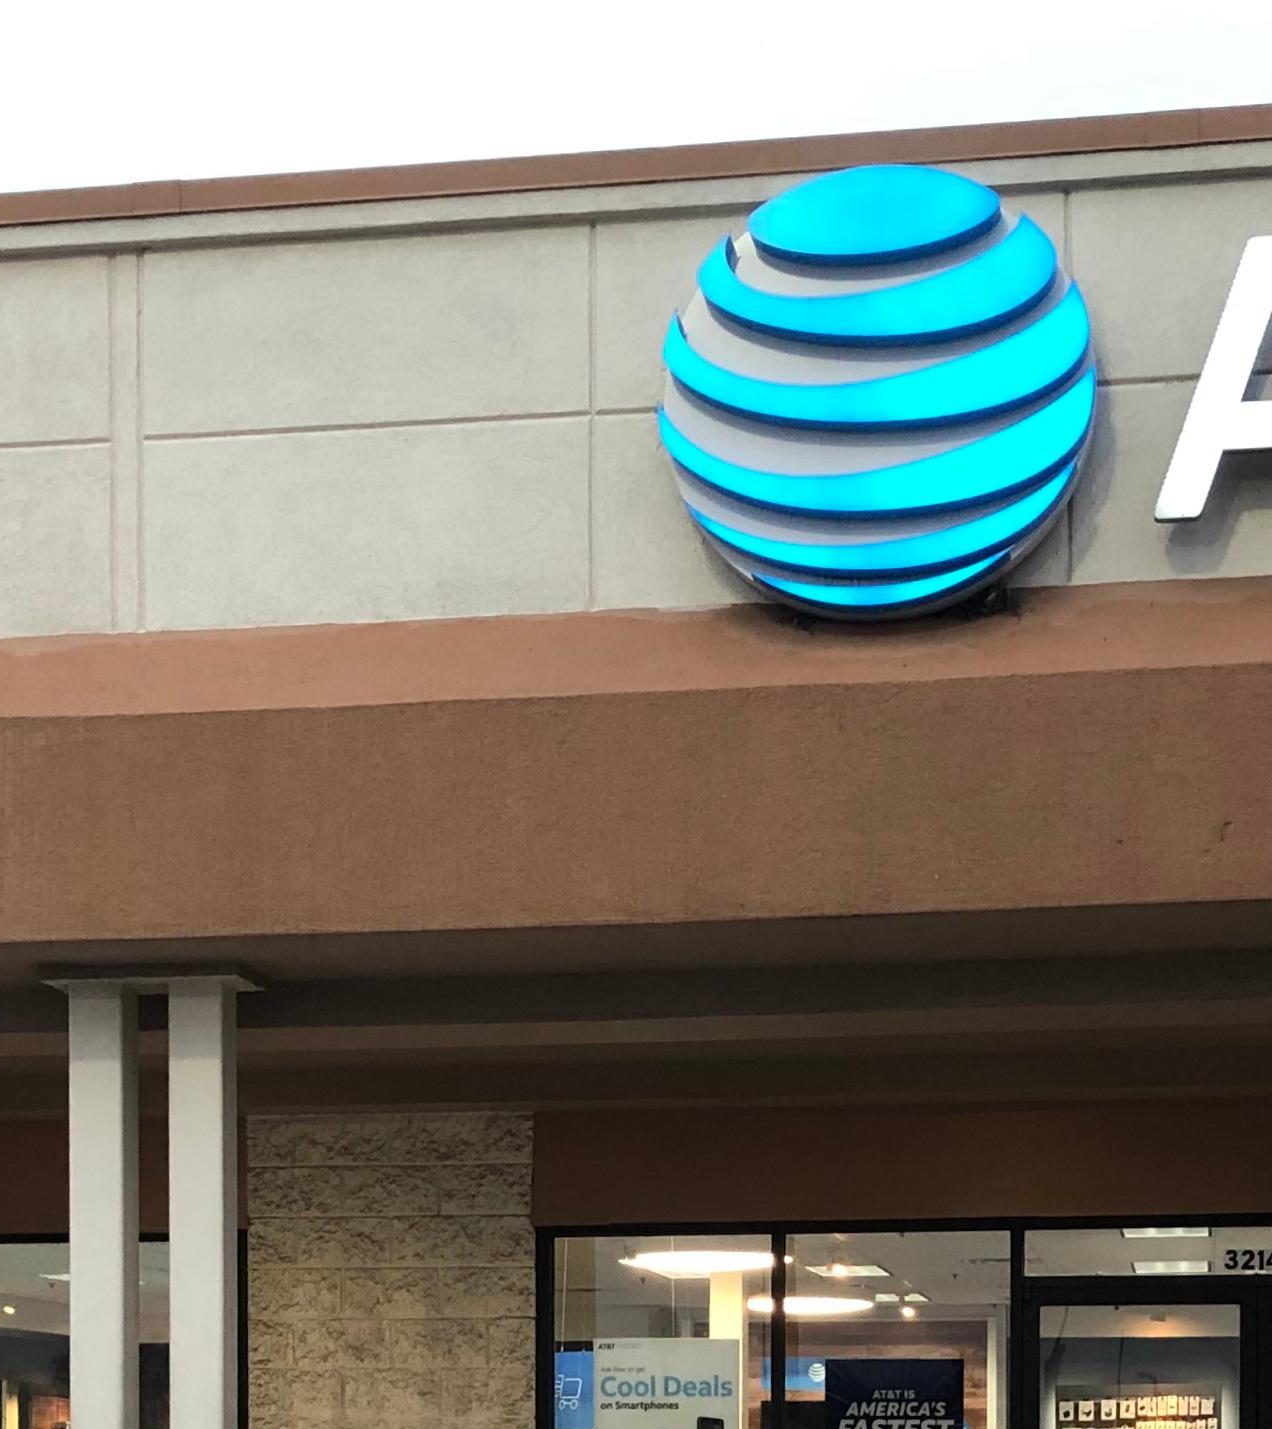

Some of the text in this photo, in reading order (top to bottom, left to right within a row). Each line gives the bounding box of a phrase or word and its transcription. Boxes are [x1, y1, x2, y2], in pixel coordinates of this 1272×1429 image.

[600, 1375, 733, 1398] Cool Deals
[872, 1390, 916, 1399] AT&T IS
[615, 1401, 679, 1411] Smartphones
[846, 1402, 947, 1416] AMERICA'S
